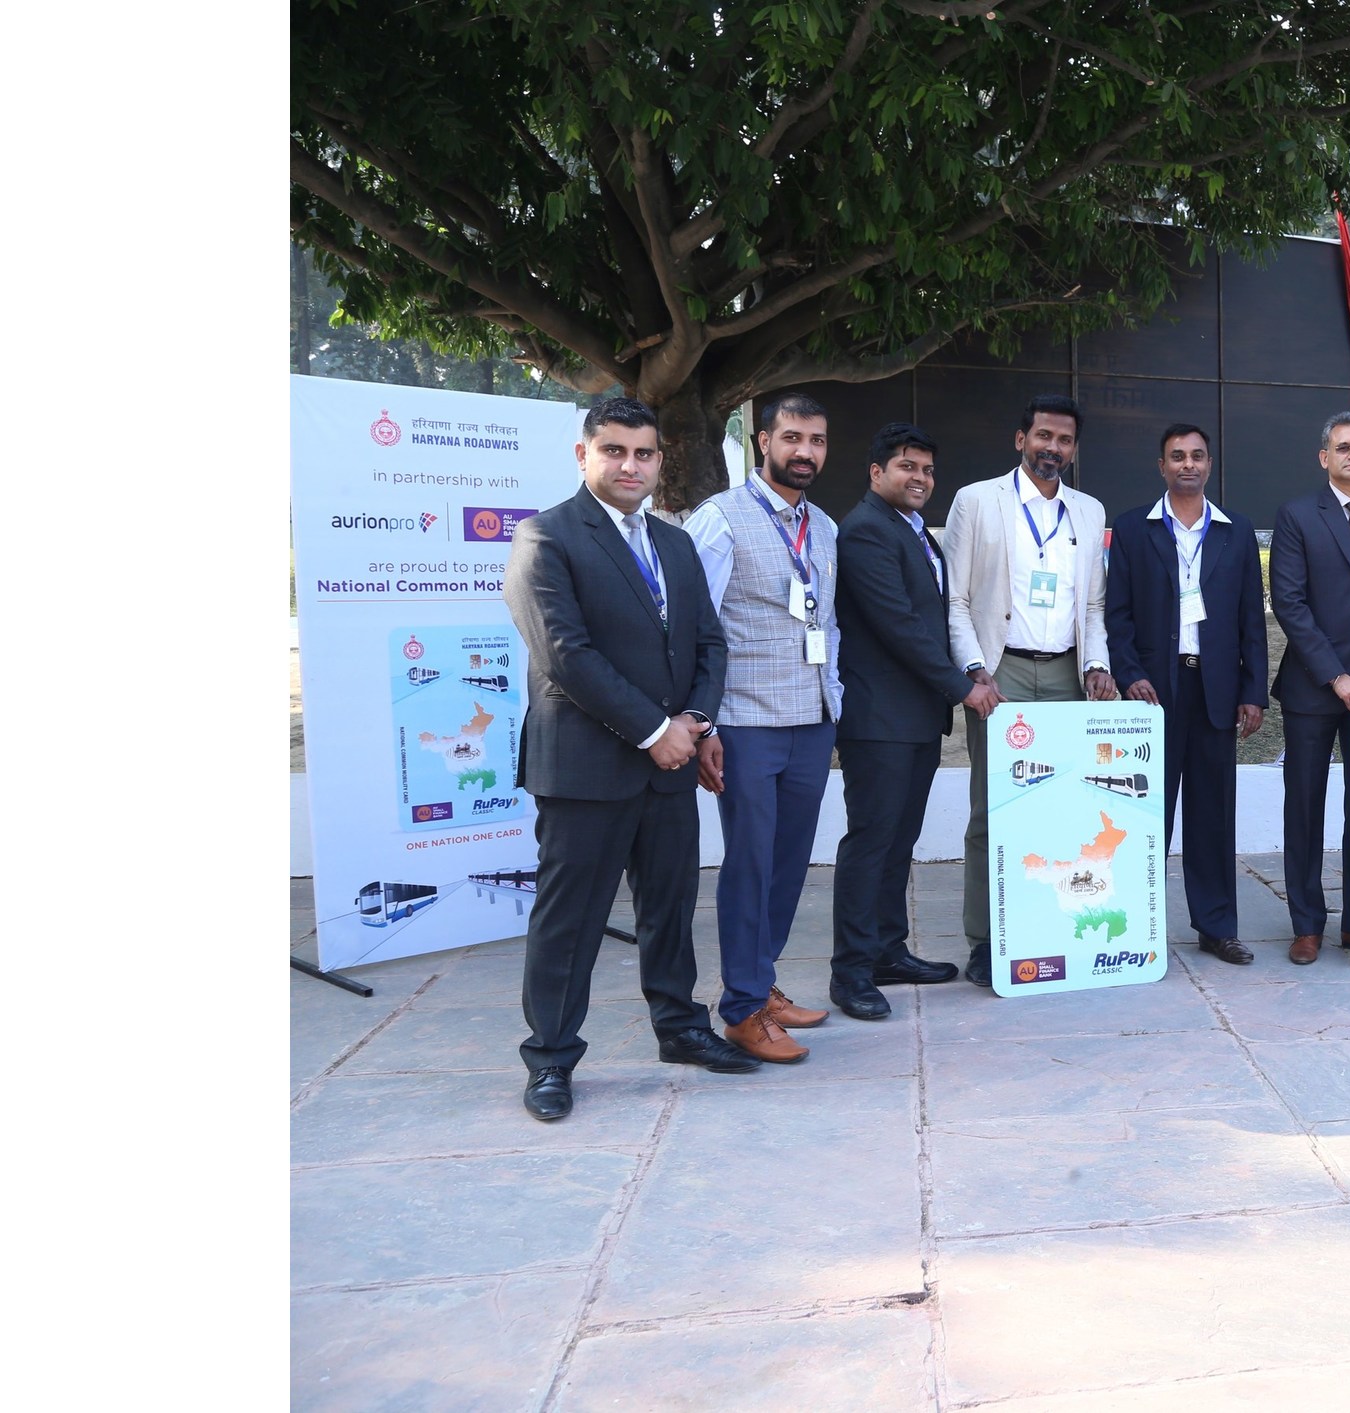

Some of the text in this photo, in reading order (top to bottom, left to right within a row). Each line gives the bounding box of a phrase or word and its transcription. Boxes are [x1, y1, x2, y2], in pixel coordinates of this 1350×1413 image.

[412, 417, 518, 436] हरियाणा राज्य परिवहन
[412, 434, 519, 450] HARYANA ROADWAYS
[373, 469, 519, 488] in partnership with
[332, 513, 414, 532] aurionpro
[476, 519, 497, 530] AU
[368, 560, 505, 574] are proud to pres
[318, 580, 390, 592] National
[396, 580, 468, 592] Common
[473, 798, 513, 810] RuPay
[407, 828, 522, 850] ONE NATION ONE CARD
[1147, 835, 1155, 850] कार्ड
[1148, 917, 1157, 942] नेशनल
[1094, 951, 1149, 967] RuPay
[1020, 967, 1035, 975] AU
[1092, 967, 1122, 975] CLASSIC
